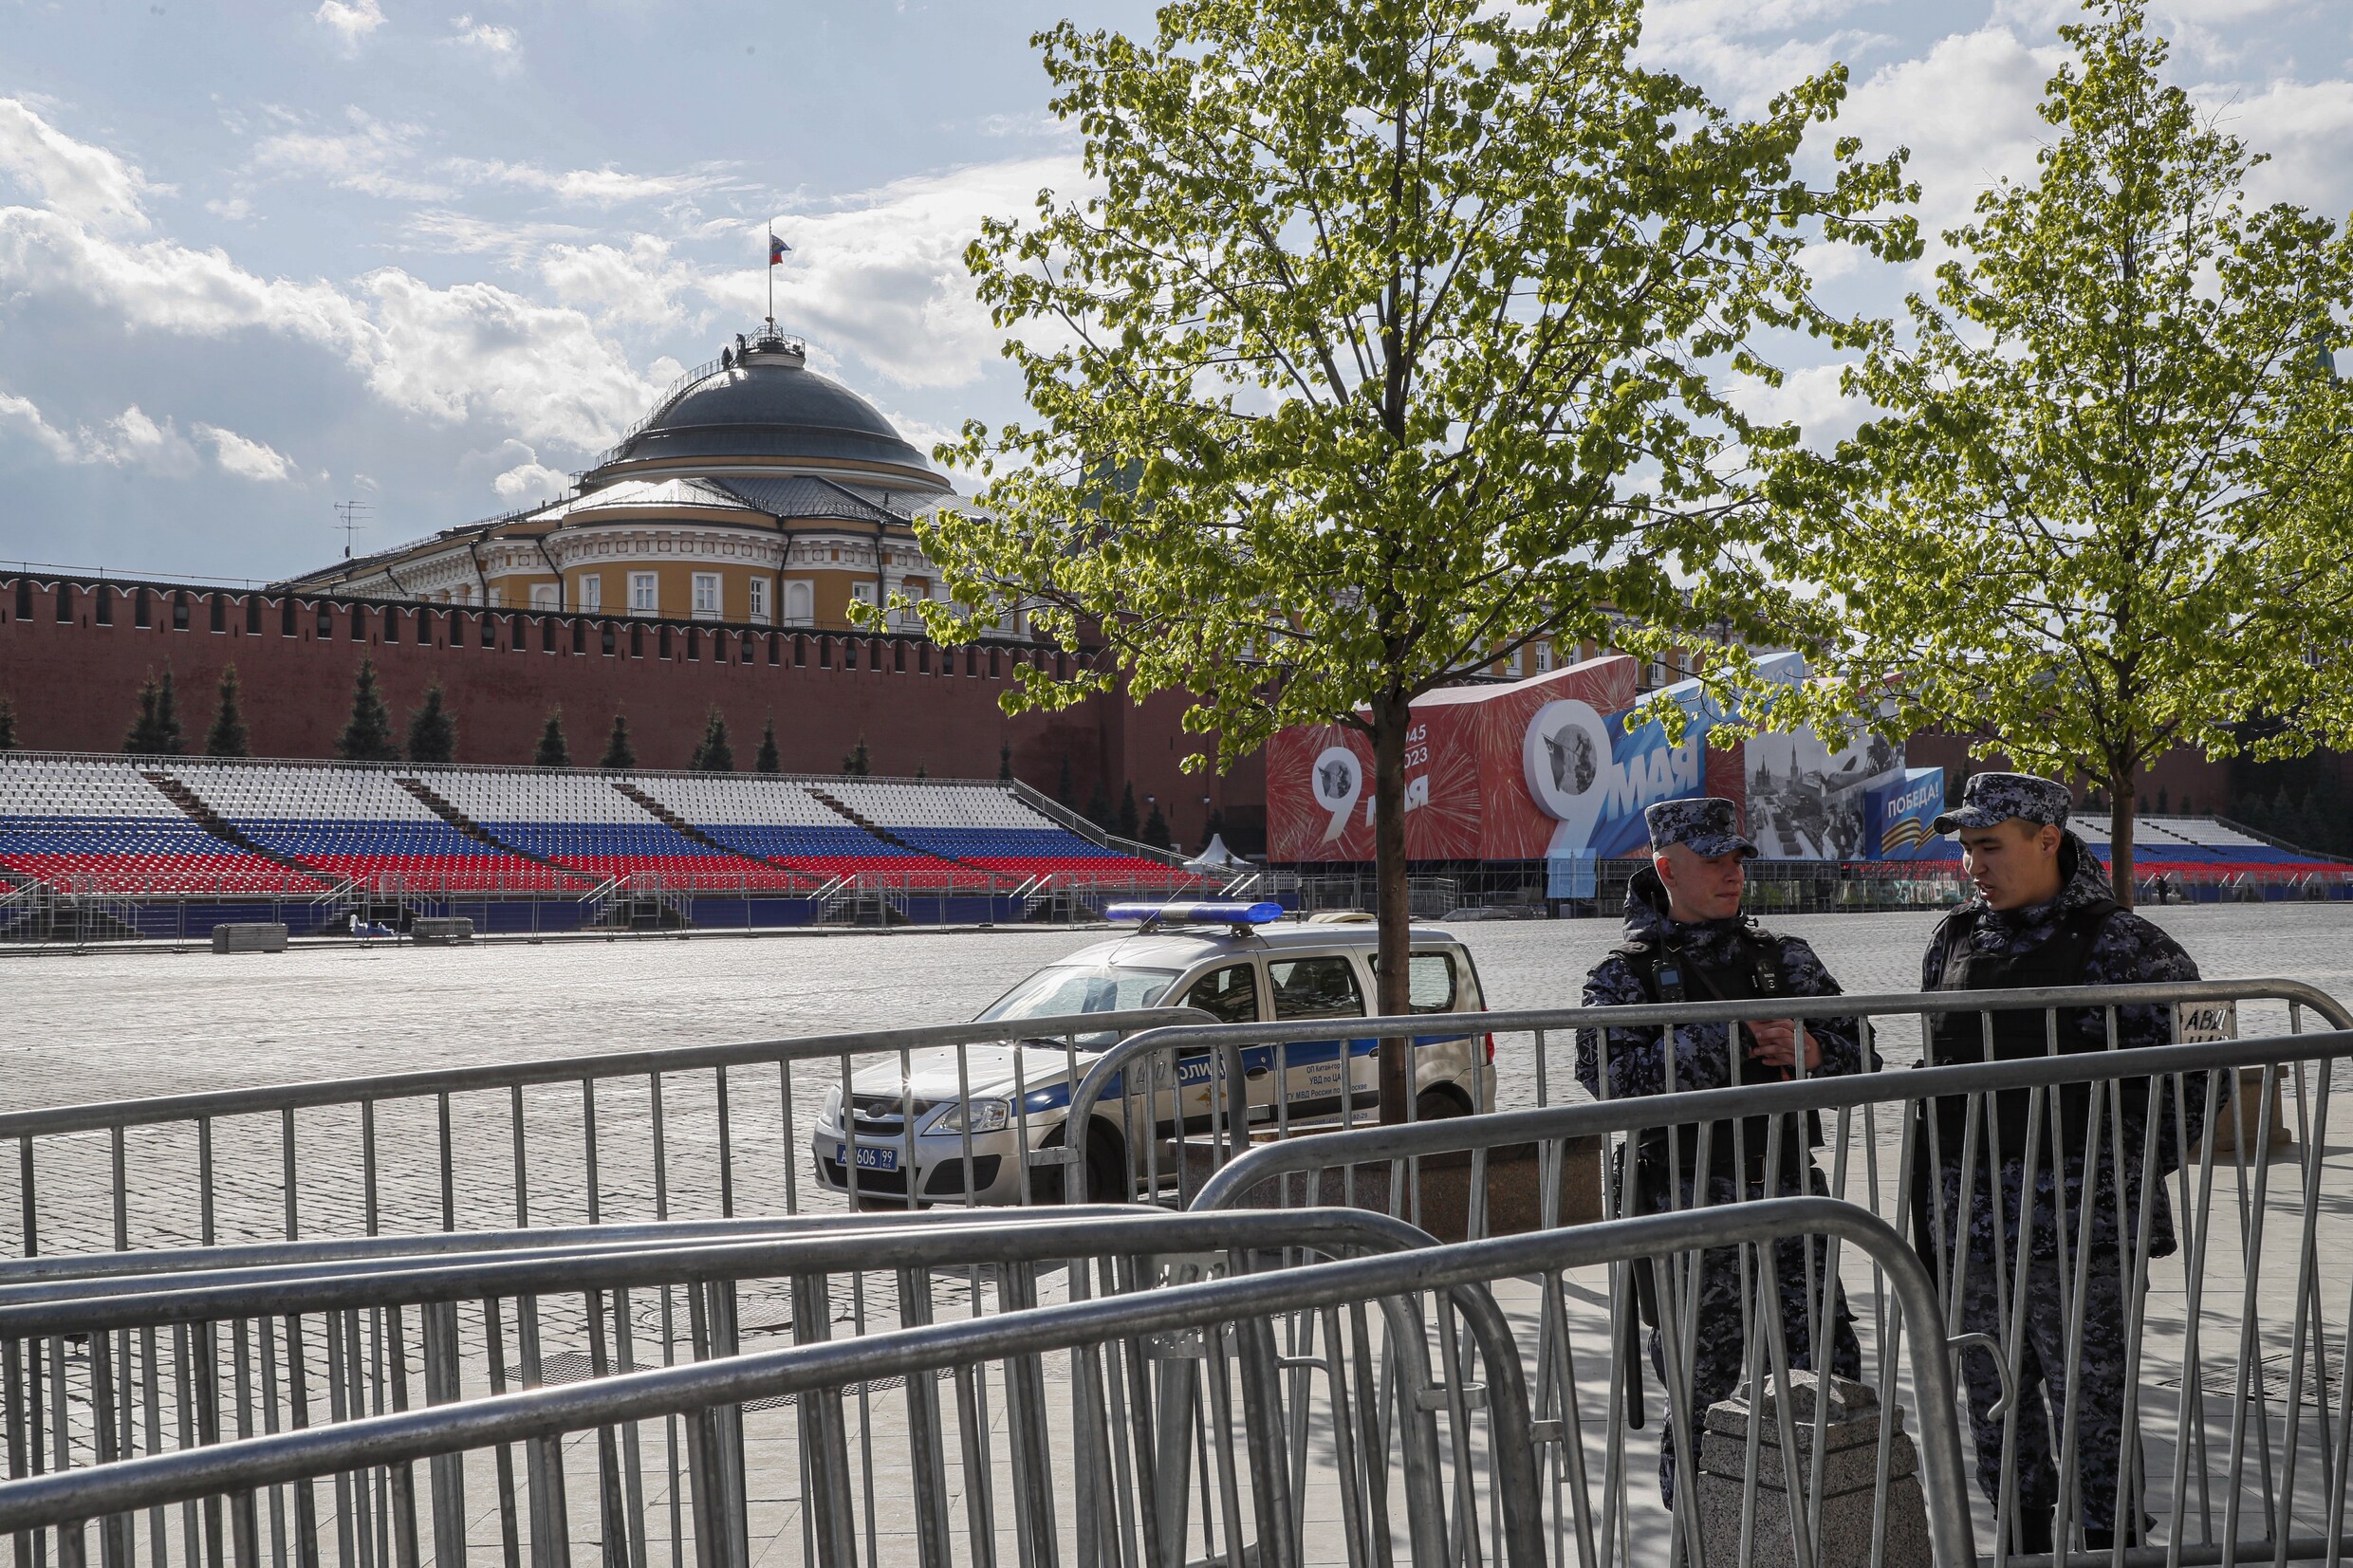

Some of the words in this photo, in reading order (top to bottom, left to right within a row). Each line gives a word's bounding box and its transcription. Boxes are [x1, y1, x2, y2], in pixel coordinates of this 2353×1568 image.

[1523, 698, 1613, 859] 9
[1606, 734, 1699, 823] МАЯ
[1311, 746, 1363, 845] 9
[1887, 781, 1939, 819] ПОБЕДА!
[1315, 1062, 1341, 1073] Китай-гор
[1309, 1075, 1323, 1085] УВД
[1332, 1073, 1341, 1083] ЦА
[1351, 1083, 1367, 1092] оскве
[881, 1150, 893, 1163] 99
